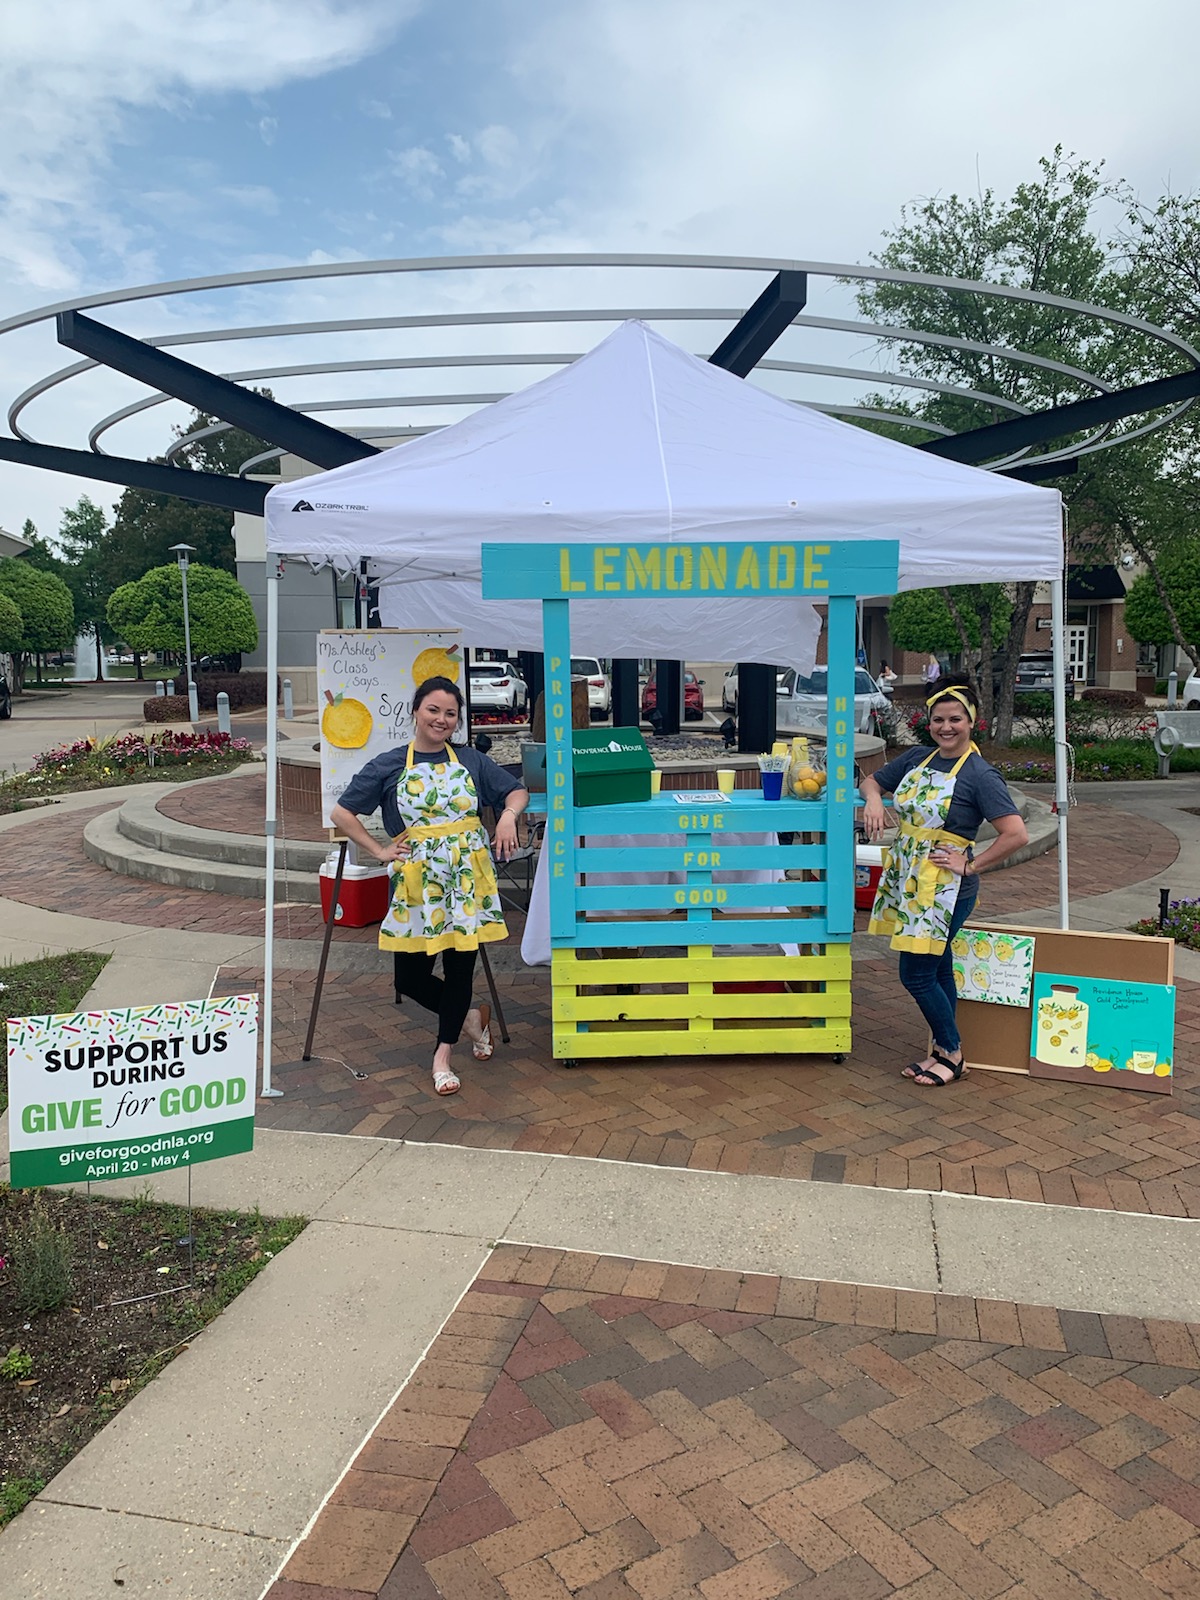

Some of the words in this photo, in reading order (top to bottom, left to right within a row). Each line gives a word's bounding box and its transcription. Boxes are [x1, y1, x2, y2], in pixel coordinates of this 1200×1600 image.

[559, 545, 831, 592] LEMONADE
[319, 641, 339, 657] Ms.
[340, 640, 386, 662] Ashley's
[333, 660, 368, 674] Class
[387, 727, 409, 740] the
[834, 696, 847, 804] HOUSE
[550, 656, 565, 878] PROVIDENCE
[678, 813, 724, 829] GIVE
[683, 851, 721, 867] FOR
[674, 888, 727, 905] GOOD
[44, 1036, 185, 1073] SUPPORT
[192, 1030, 229, 1056] US
[93, 1061, 186, 1088] DURING
[21, 1097, 103, 1134] GIVE
[106, 1090, 156, 1129] for
[159, 1077, 247, 1117] GOOD
[59, 1129, 215, 1166] giveforgoodnla.org
[86, 1162, 119, 1178] April
[122, 1160, 139, 1173] 20
[151, 1155, 178, 1169] May
[182, 1150, 191, 1161] 4
